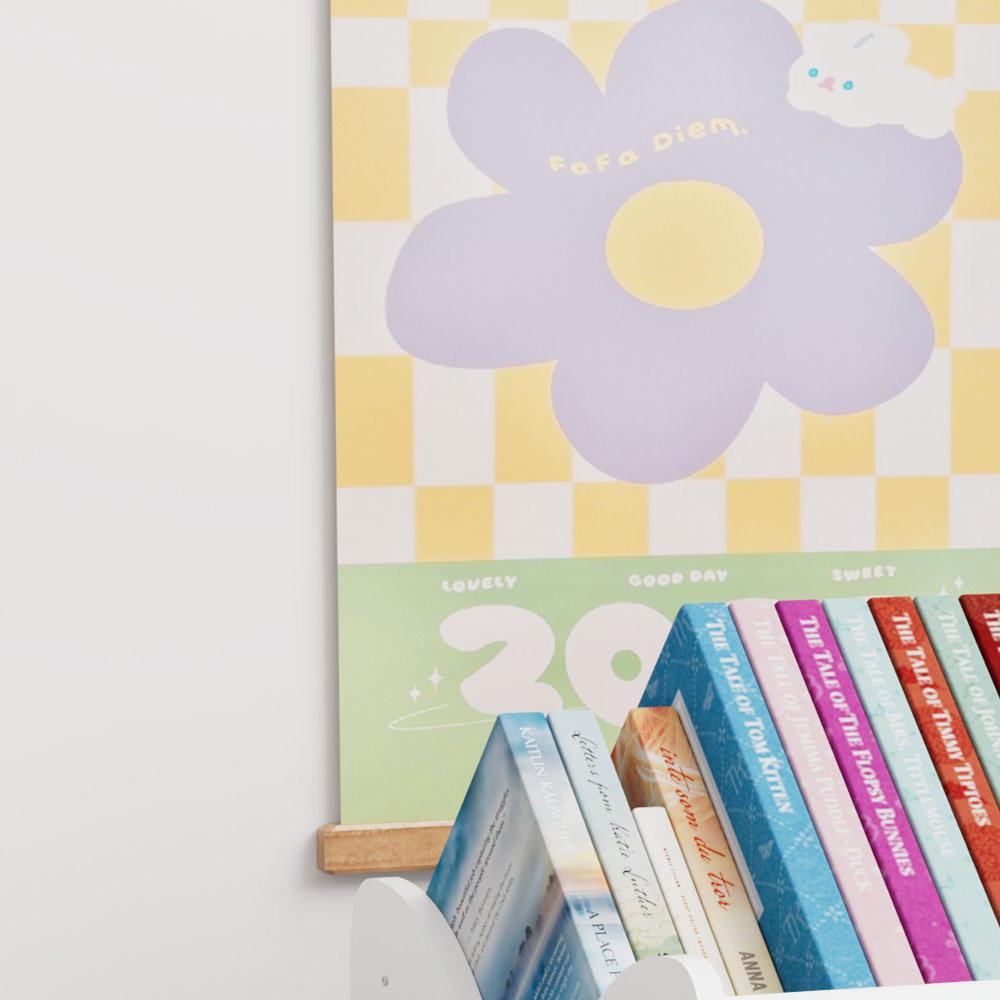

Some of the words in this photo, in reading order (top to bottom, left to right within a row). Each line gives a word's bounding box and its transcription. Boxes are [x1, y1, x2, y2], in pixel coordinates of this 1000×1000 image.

[442, 575, 518, 593] LOVELY
[628, 571, 684, 588] GOOD
[688, 569, 729, 583] DAY
[831, 564, 898, 582] SWEET
[938, 609, 962, 642] THE
[952, 643, 979, 683] TALE
[968, 685, 989, 707] OF
[707, 618, 730, 651] THE
[720, 652, 746, 692] TALE
[735, 694, 755, 715] OF
[746, 719, 770, 753] TOM
[759, 755, 793, 813] KITTEN
[892, 611, 916, 644] THE
[906, 645, 933, 685] TALE
[921, 686, 943, 708] OF
[932, 708, 964, 760] TIMMY
[954, 761, 992, 827] TIPTOES
[518, 726, 549, 777] KAITLIN
[799, 614, 824, 648] THE
[813, 649, 841, 689] TALE
[828, 690, 850, 711] OF
[839, 712, 864, 747] THE
[853, 748, 888, 805] FLOPSY
[876, 807, 917, 877] BUNNIES
[660, 747, 694, 793] inte
[675, 789, 699, 831] som
[694, 836, 726, 864] du
[708, 871, 735, 911] tror
[592, 924, 619, 970] PLACE
[739, 951, 767, 992] ANNA
